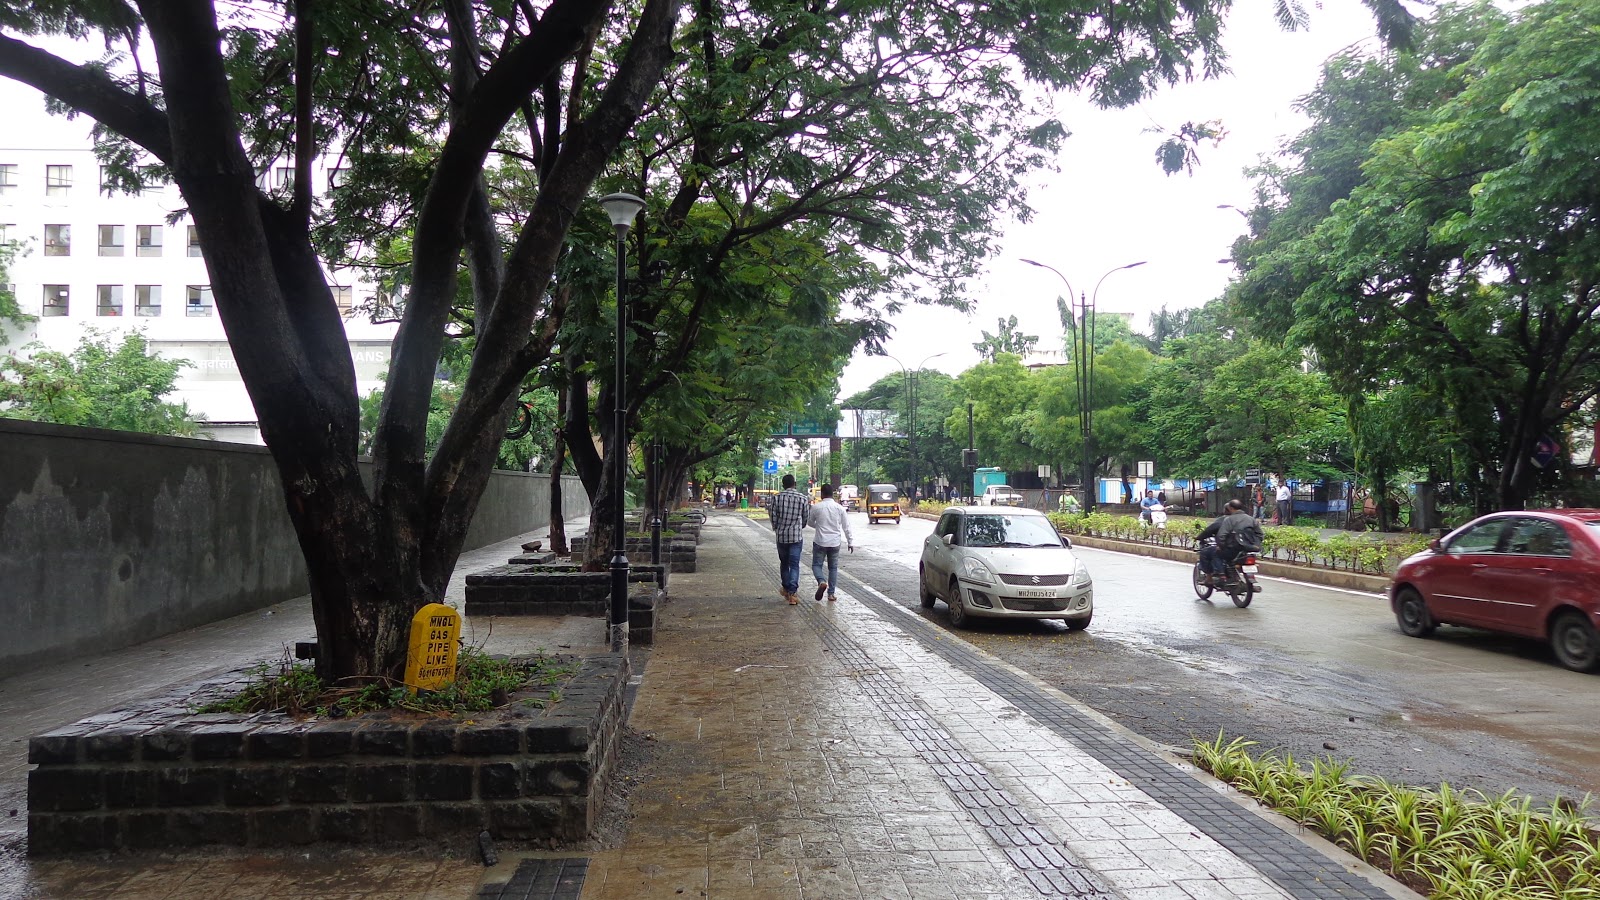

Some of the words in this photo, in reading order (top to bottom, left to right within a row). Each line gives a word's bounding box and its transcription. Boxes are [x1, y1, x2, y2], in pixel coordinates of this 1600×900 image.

[352, 351, 384, 362] ANS
[768, 461, 774, 469] P
[430, 616, 453, 627] MNGL
[430, 630, 448, 640] GAS
[427, 642, 449, 653] PIPE
[426, 655, 448, 665] LINE
